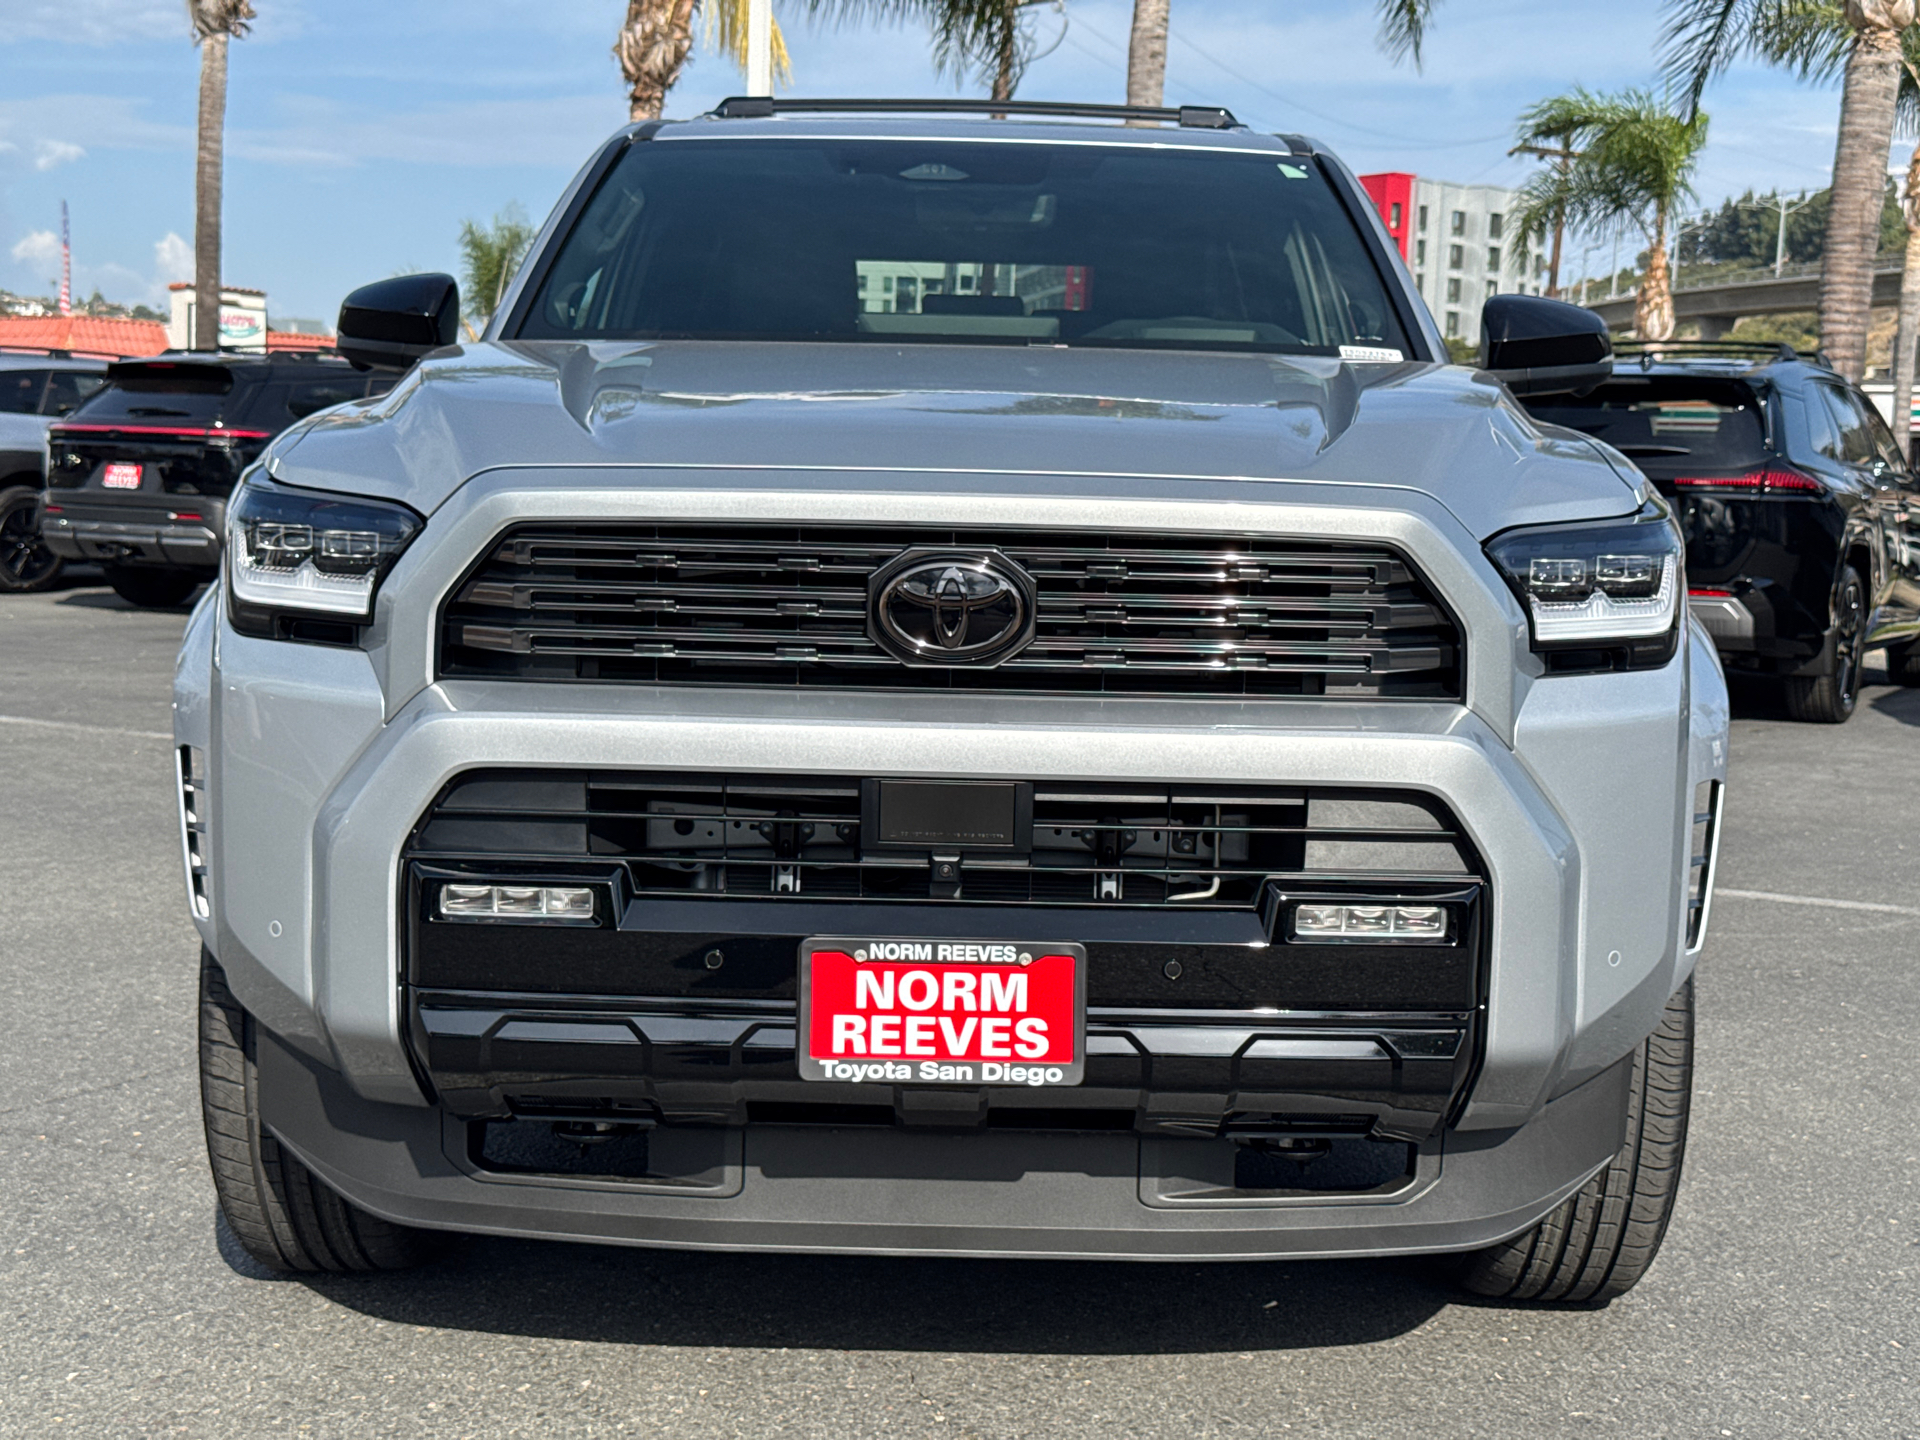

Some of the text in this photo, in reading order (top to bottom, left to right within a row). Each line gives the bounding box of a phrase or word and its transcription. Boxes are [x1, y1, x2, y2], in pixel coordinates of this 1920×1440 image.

[869, 943, 1017, 962] NORM REEVES
[855, 970, 1028, 1012] NORM
[832, 1014, 1050, 1059] REEVES
[819, 1060, 1063, 1086] Toyota San Diego
